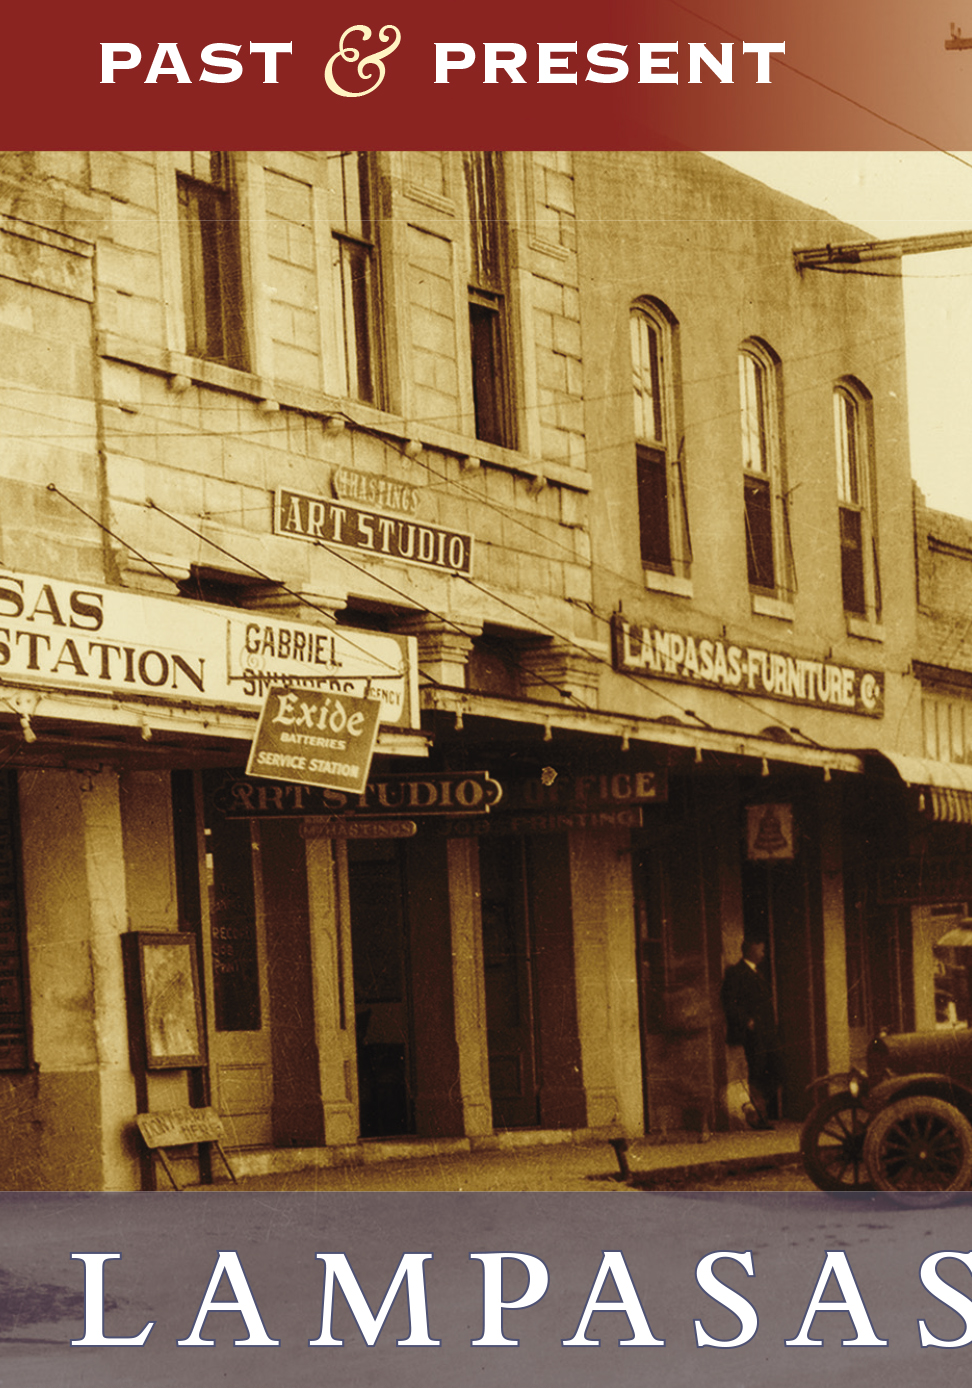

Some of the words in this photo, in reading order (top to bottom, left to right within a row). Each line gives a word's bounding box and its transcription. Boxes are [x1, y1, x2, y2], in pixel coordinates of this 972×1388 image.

[285, 497, 347, 542] ART
[357, 512, 464, 569] STUDIO
[245, 623, 342, 667] GABRIEL
[272, 692, 365, 736] Exide
[279, 731, 347, 751] BATTERIES
[256, 751, 306, 770] SERVICE
[308, 757, 360, 779] STATION
[231, 782, 306, 811] ART
[322, 779, 484, 809] STUDIO
